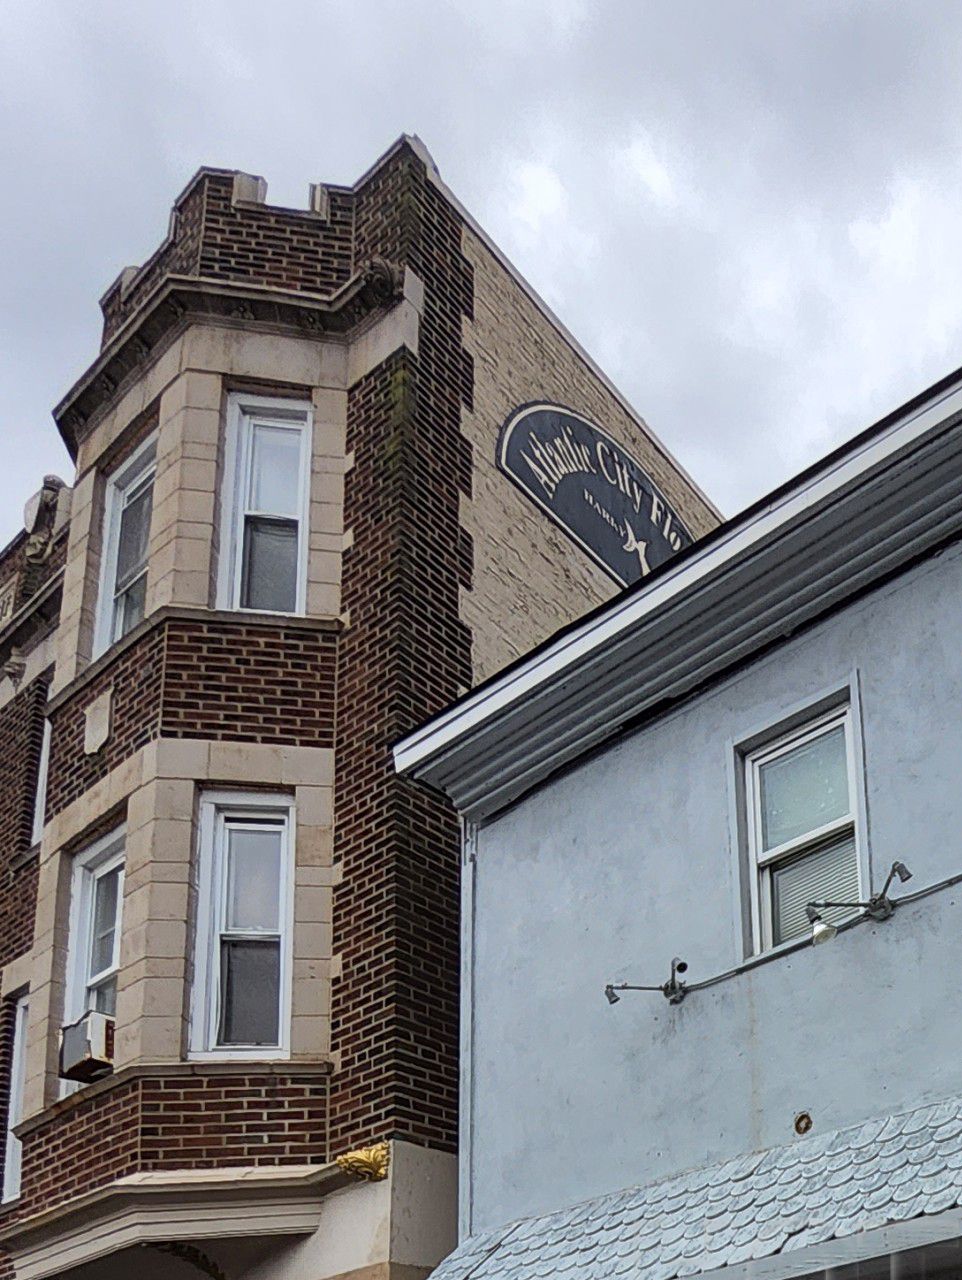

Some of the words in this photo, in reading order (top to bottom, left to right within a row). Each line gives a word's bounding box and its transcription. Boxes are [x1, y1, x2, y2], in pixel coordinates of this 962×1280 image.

[520, 426, 597, 499] Atlantic
[595, 441, 643, 514] City
[651, 489, 682, 551] Flo
